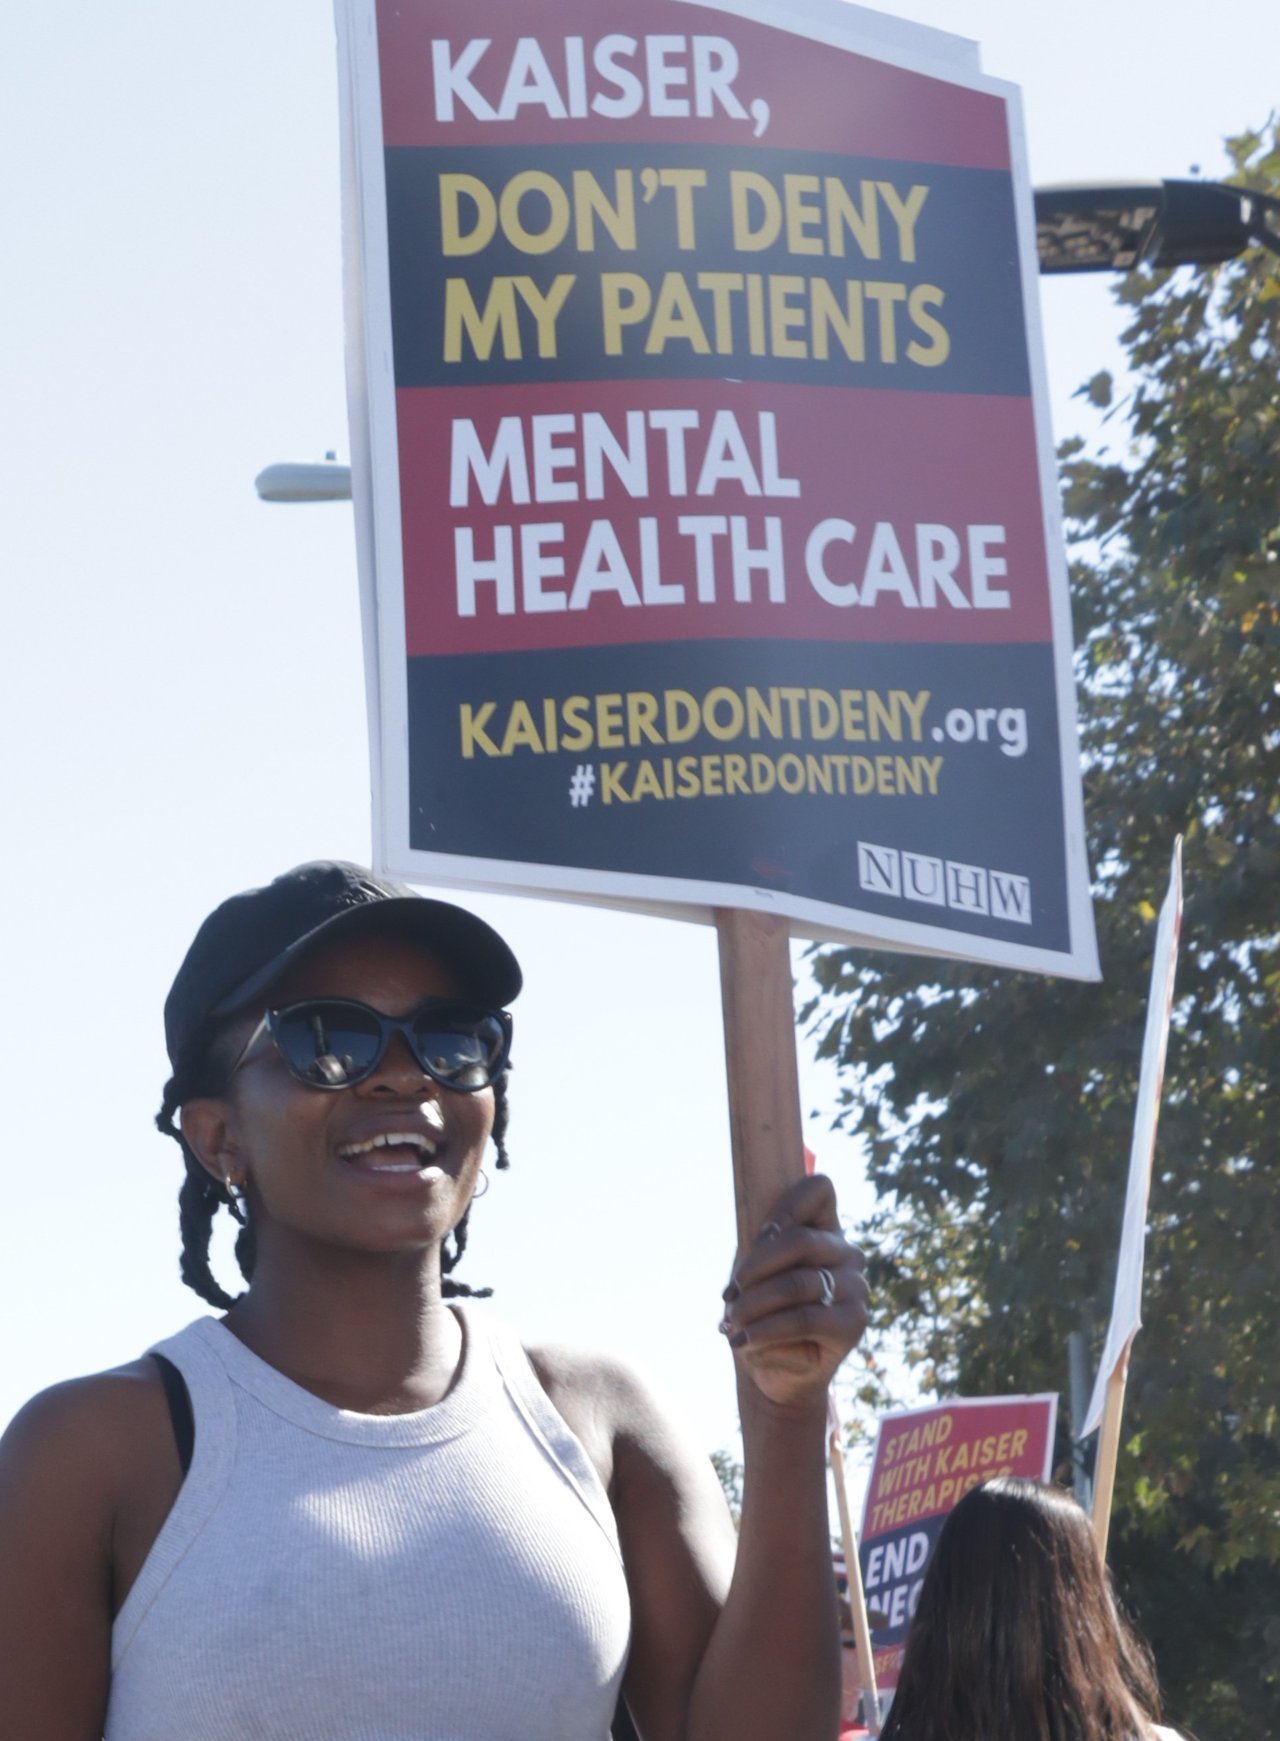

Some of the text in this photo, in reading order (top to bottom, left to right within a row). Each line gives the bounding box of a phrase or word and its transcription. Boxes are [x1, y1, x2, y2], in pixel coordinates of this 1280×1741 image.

[431, 33, 771, 138] KAISER,
[438, 166, 930, 263] DON’T DENY
[443, 272, 951, 368] MY PATIENTS
[449, 408, 801, 509] MENTAL
[453, 514, 1011, 617] HEALTH CARE
[459, 686, 1029, 758] KAISERDONTDENY.org
[569, 755, 944, 807] #KAISERDONTDENY
[860, 844, 1032, 922] NUHW
[877, 1428, 1029, 1499] WITH KAISER
[883, 1414, 953, 1466] STAND
[865, 1531, 930, 1588] END
